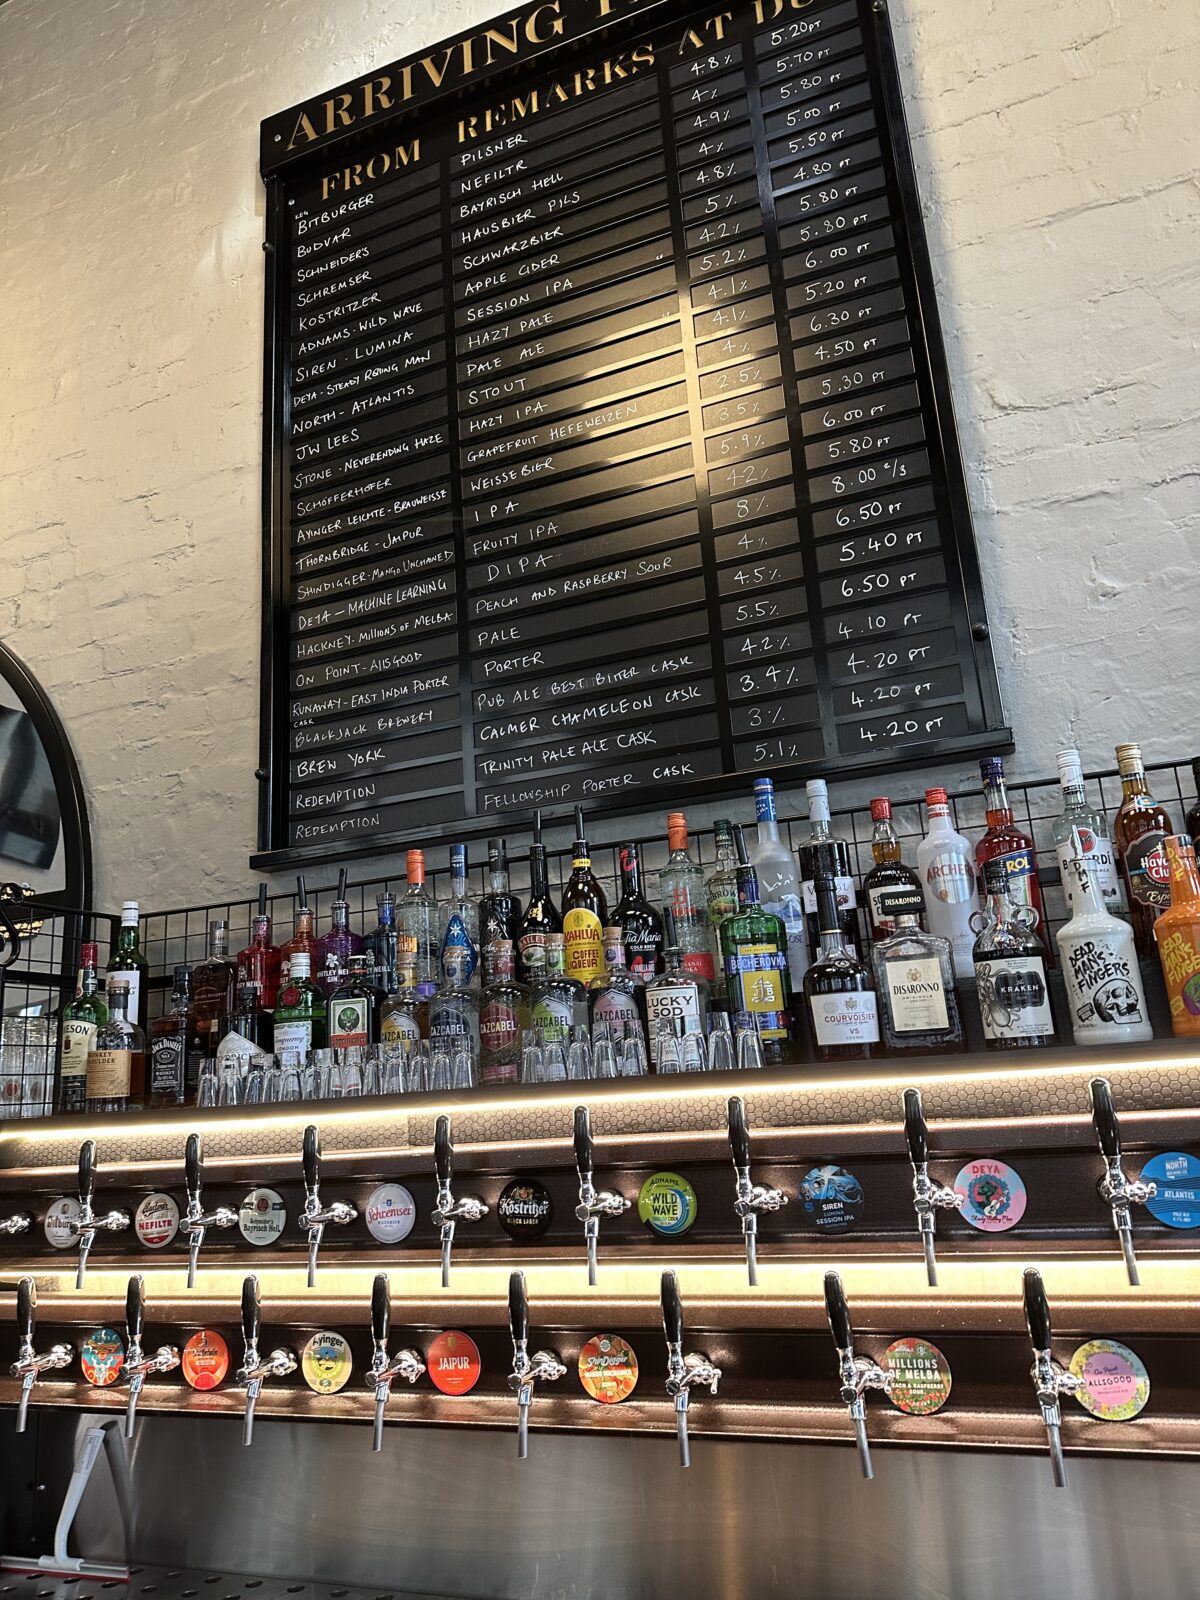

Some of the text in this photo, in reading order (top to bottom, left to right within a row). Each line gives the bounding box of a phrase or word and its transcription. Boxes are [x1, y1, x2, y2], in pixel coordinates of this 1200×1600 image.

[771, 22, 808, 46] 5.20
[777, 52, 813, 72] 5.70
[284, 2, 568, 151] ARRIVING
[780, 75, 821, 99] 5.80
[320, 12, 732, 201] FROM REMARKS AT
[787, 108, 820, 125] 5.00
[461, 133, 528, 166] PILSNER
[789, 132, 827, 153] 5.50
[461, 160, 527, 193] NEFILTR
[793, 162, 831, 180] 4.80
[460, 173, 563, 217] BAYRISCH HELL
[800, 189, 838, 211] 5.80
[298, 193, 374, 235] BITBURGER
[462, 191, 580, 243] HAUSBIER PILS
[800, 216, 845, 242] 5.80
[297, 228, 351, 257] BUDVAR
[463, 226, 563, 270] SCHWARZBIER
[297, 247, 369, 282] SCHNEIDER'S
[805, 247, 847, 268] 6.00
[464, 254, 560, 296] APPLE CIDER
[297, 271, 371, 307] SCHREMSER
[467, 279, 573, 321] SESSION IPA
[805, 281, 844, 301] 5.20
[300, 293, 381, 331] KOSTRITZER
[810, 311, 849, 331] 6.30
[298, 303, 422, 355] ADNAMS WILD WAVE
[468, 313, 554, 348] HAZY PALE
[296, 331, 413, 381] SIREN LUMINA
[467, 343, 545, 376] PALE ALE
[815, 340, 855, 360] 4.50
[293, 350, 430, 407] DEYA STEADY MAN
[822, 372, 863, 396] 5.30
[468, 378, 527, 405] STOUT
[293, 385, 414, 434] NORTH ATLANTIS
[470, 401, 548, 432] HAZY IPA
[823, 409, 863, 427] 6.00
[296, 429, 359, 460] JW LEES
[467, 403, 638, 462] GRAPEFRUIT HEFEWEIZEN
[828, 437, 872, 458] 5.80
[294, 469, 332, 488] STONE
[414, 434, 443, 449] HAZE
[832, 468, 876, 493] 8.00
[297, 489, 447, 542] AYINGER LEICHTE BRAUWEISSE
[836, 502, 882, 527] 6.50
[295, 527, 423, 570] THORNBRIDGE JAIPUR
[473, 522, 559, 555] FRUITY IPA
[840, 533, 897, 562] 5.40
[348, 594, 392, 615] MACHINE
[396, 579, 447, 602] LEARNING
[476, 557, 673, 613] PEACH AND RASPBERRY SOUR
[842, 573, 889, 597] 6.50
[414, 612, 453, 628] MELBA
[839, 615, 886, 639] 4.10
[478, 627, 521, 646] PALE
[296, 663, 360, 687] ON POINT
[484, 651, 544, 676] PORTER
[847, 653, 897, 674] 4.20
[477, 656, 694, 711] PUB ALE BEST CASK
[293, 676, 450, 717] RUNAWAY EAST INDIA PORTER
[852, 686, 900, 708] 4.20
[293, 719, 314, 728] CASK
[480, 686, 702, 740] CALMER CHAMELEON CASK
[295, 710, 432, 748] BLACKJACK BREWERY
[860, 720, 918, 741] 4.20
[297, 748, 386, 777] BREW YORK
[479, 730, 657, 775] TRINITY PALE ALE CASK
[296, 784, 376, 809] REDEMPTION
[484, 764, 695, 810] FELLOWSHIP PORTER CASK
[296, 814, 380, 839] REDEMPTION
[885, 896, 921, 906] DISARONNO
[567, 959, 598, 970] LIQUEUR
[572, 949, 599, 959] COFFEE
[731, 956, 787, 970] BECHEROVKA
[1069, 942, 1096, 967] DEAD
[1073, 951, 1107, 979] MAN'S
[893, 983, 940, 995] DISARONNO
[1000, 984, 1039, 993] KRAKEN
[1078, 962, 1131, 993] FINGERS
[648, 996, 693, 1009] LUCKY
[653, 1007, 683, 1018] SOD
[824, 1013, 875, 1023] COURVOISIER
[972, 1164, 1001, 1174] DEYA
[1165, 1159, 1189, 1170] NORTH
[649, 1178, 681, 1186] ADNAMS
[651, 1193, 678, 1204] WILD
[822, 1202, 844, 1211] SIREN
[1164, 1190, 1195, 1200] ATLANTIS
[367, 1207, 413, 1223] Schremser
[651, 1204, 678, 1216] WAVE
[816, 1217, 844, 1225] SESSION
[138, 1219, 173, 1231] NEFILTR
[438, 1356, 470, 1371] JAIPUR
[888, 1358, 938, 1369] MILLIONS
[905, 1369, 941, 1380] MELBA
[1088, 1376, 1132, 1387] ALLSGOOD
